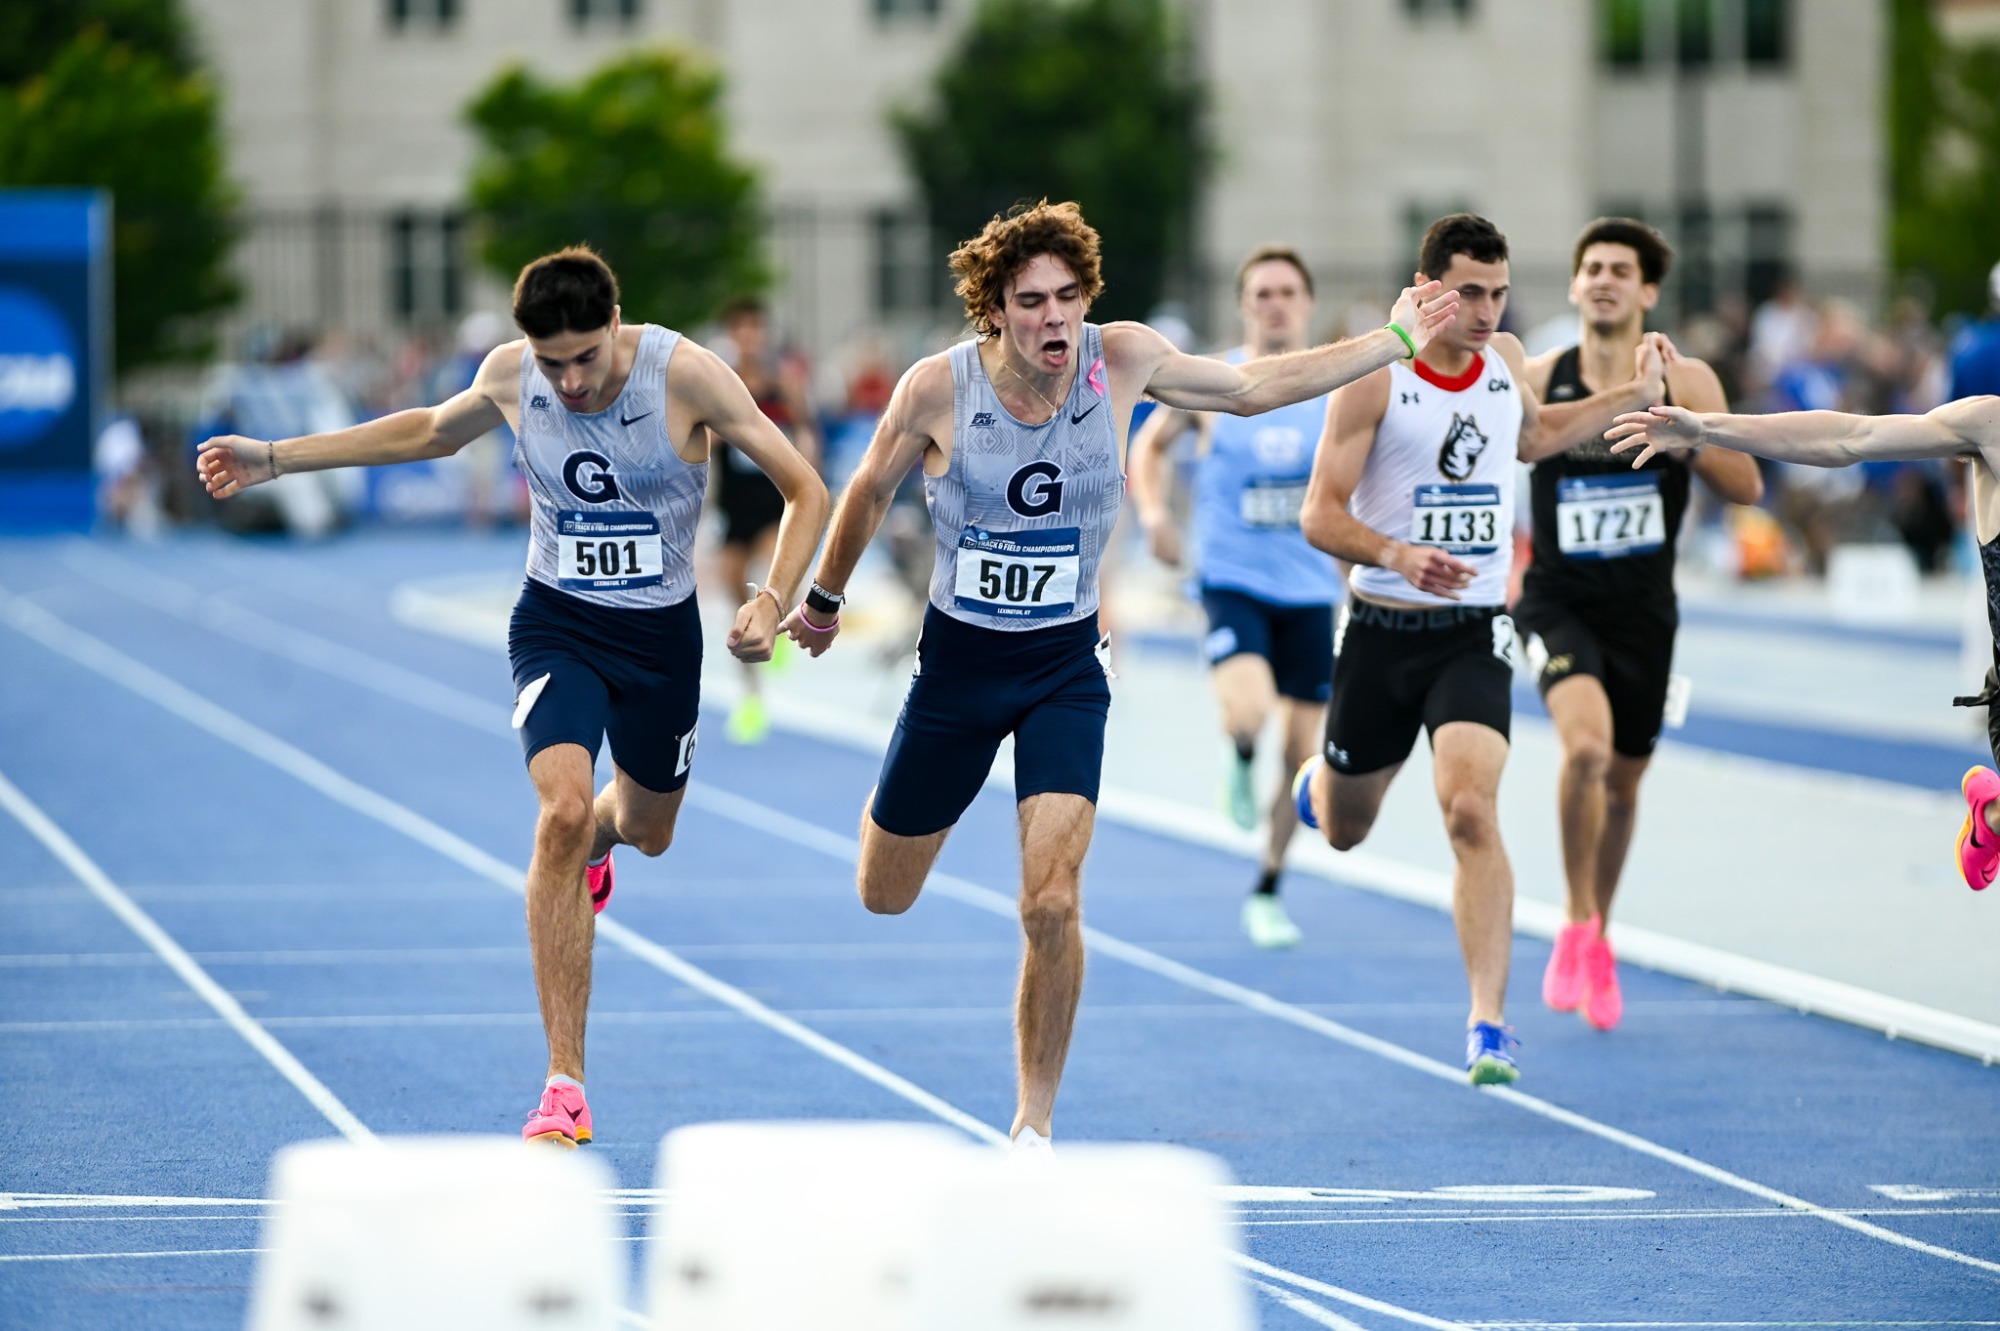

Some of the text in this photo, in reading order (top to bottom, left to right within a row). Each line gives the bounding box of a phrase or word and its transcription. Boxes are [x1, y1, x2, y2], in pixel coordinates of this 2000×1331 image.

[562, 450, 623, 504] G
[1006, 460, 1066, 519] G
[1420, 511, 1495, 541] 1133
[1573, 504, 1651, 541] 1727
[576, 540, 642, 576] 501
[978, 541, 998, 549] TRACK
[1003, 544, 1021, 552] FIELD
[1022, 544, 1074, 553] CHAMPIONSHIPS
[980, 559, 1056, 602] 507
[684, 728, 697, 766] 6
